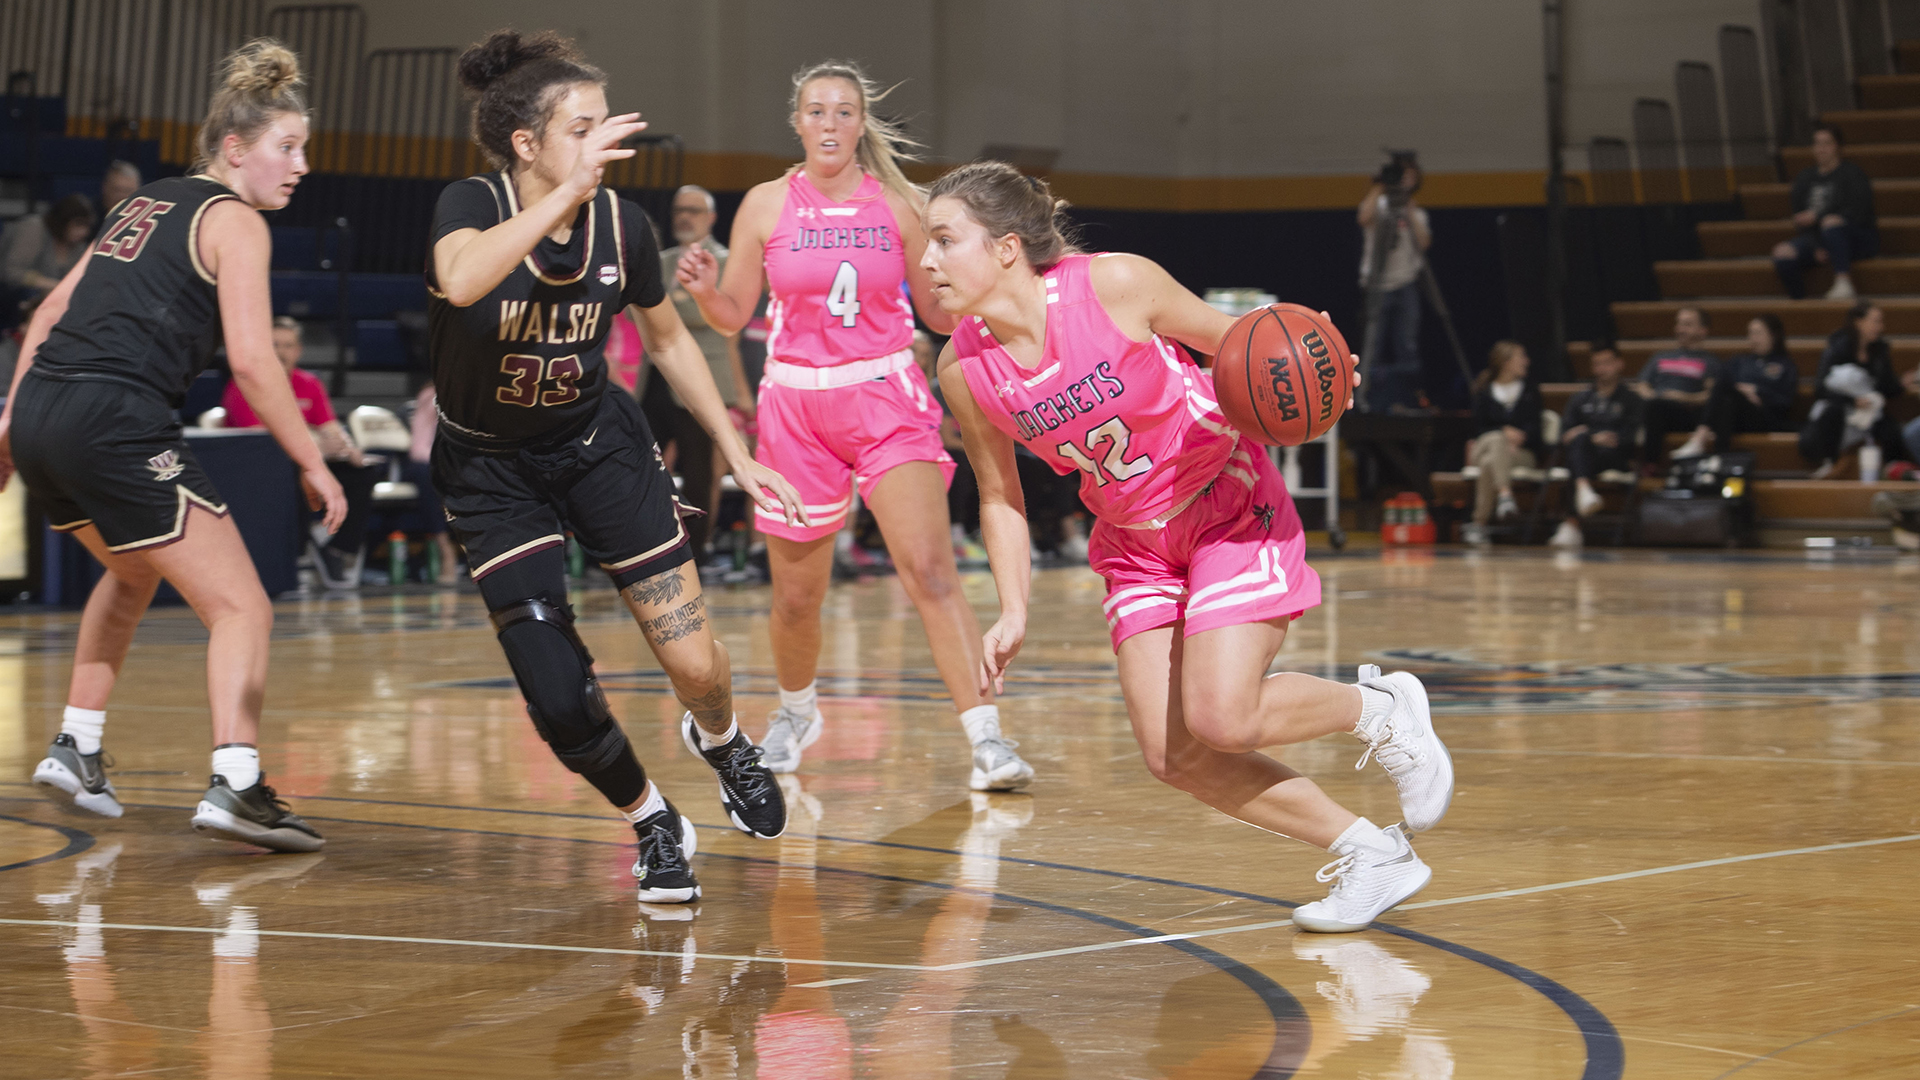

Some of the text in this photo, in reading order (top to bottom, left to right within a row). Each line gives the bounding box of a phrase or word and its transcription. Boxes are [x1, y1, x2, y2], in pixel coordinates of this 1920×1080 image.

[93, 196, 177, 262] 25
[790, 226, 891, 252] JACKETS
[498, 300, 602, 344] WALSH
[826, 260, 861, 328] 4
[496, 353, 583, 408] 33
[1011, 361, 1125, 441] JACKETS
[1268, 357, 1301, 422] NCAA
[1301, 328, 1336, 422] Wilson
[1056, 415, 1153, 487] 12
[650, 611, 676, 631] WITH
